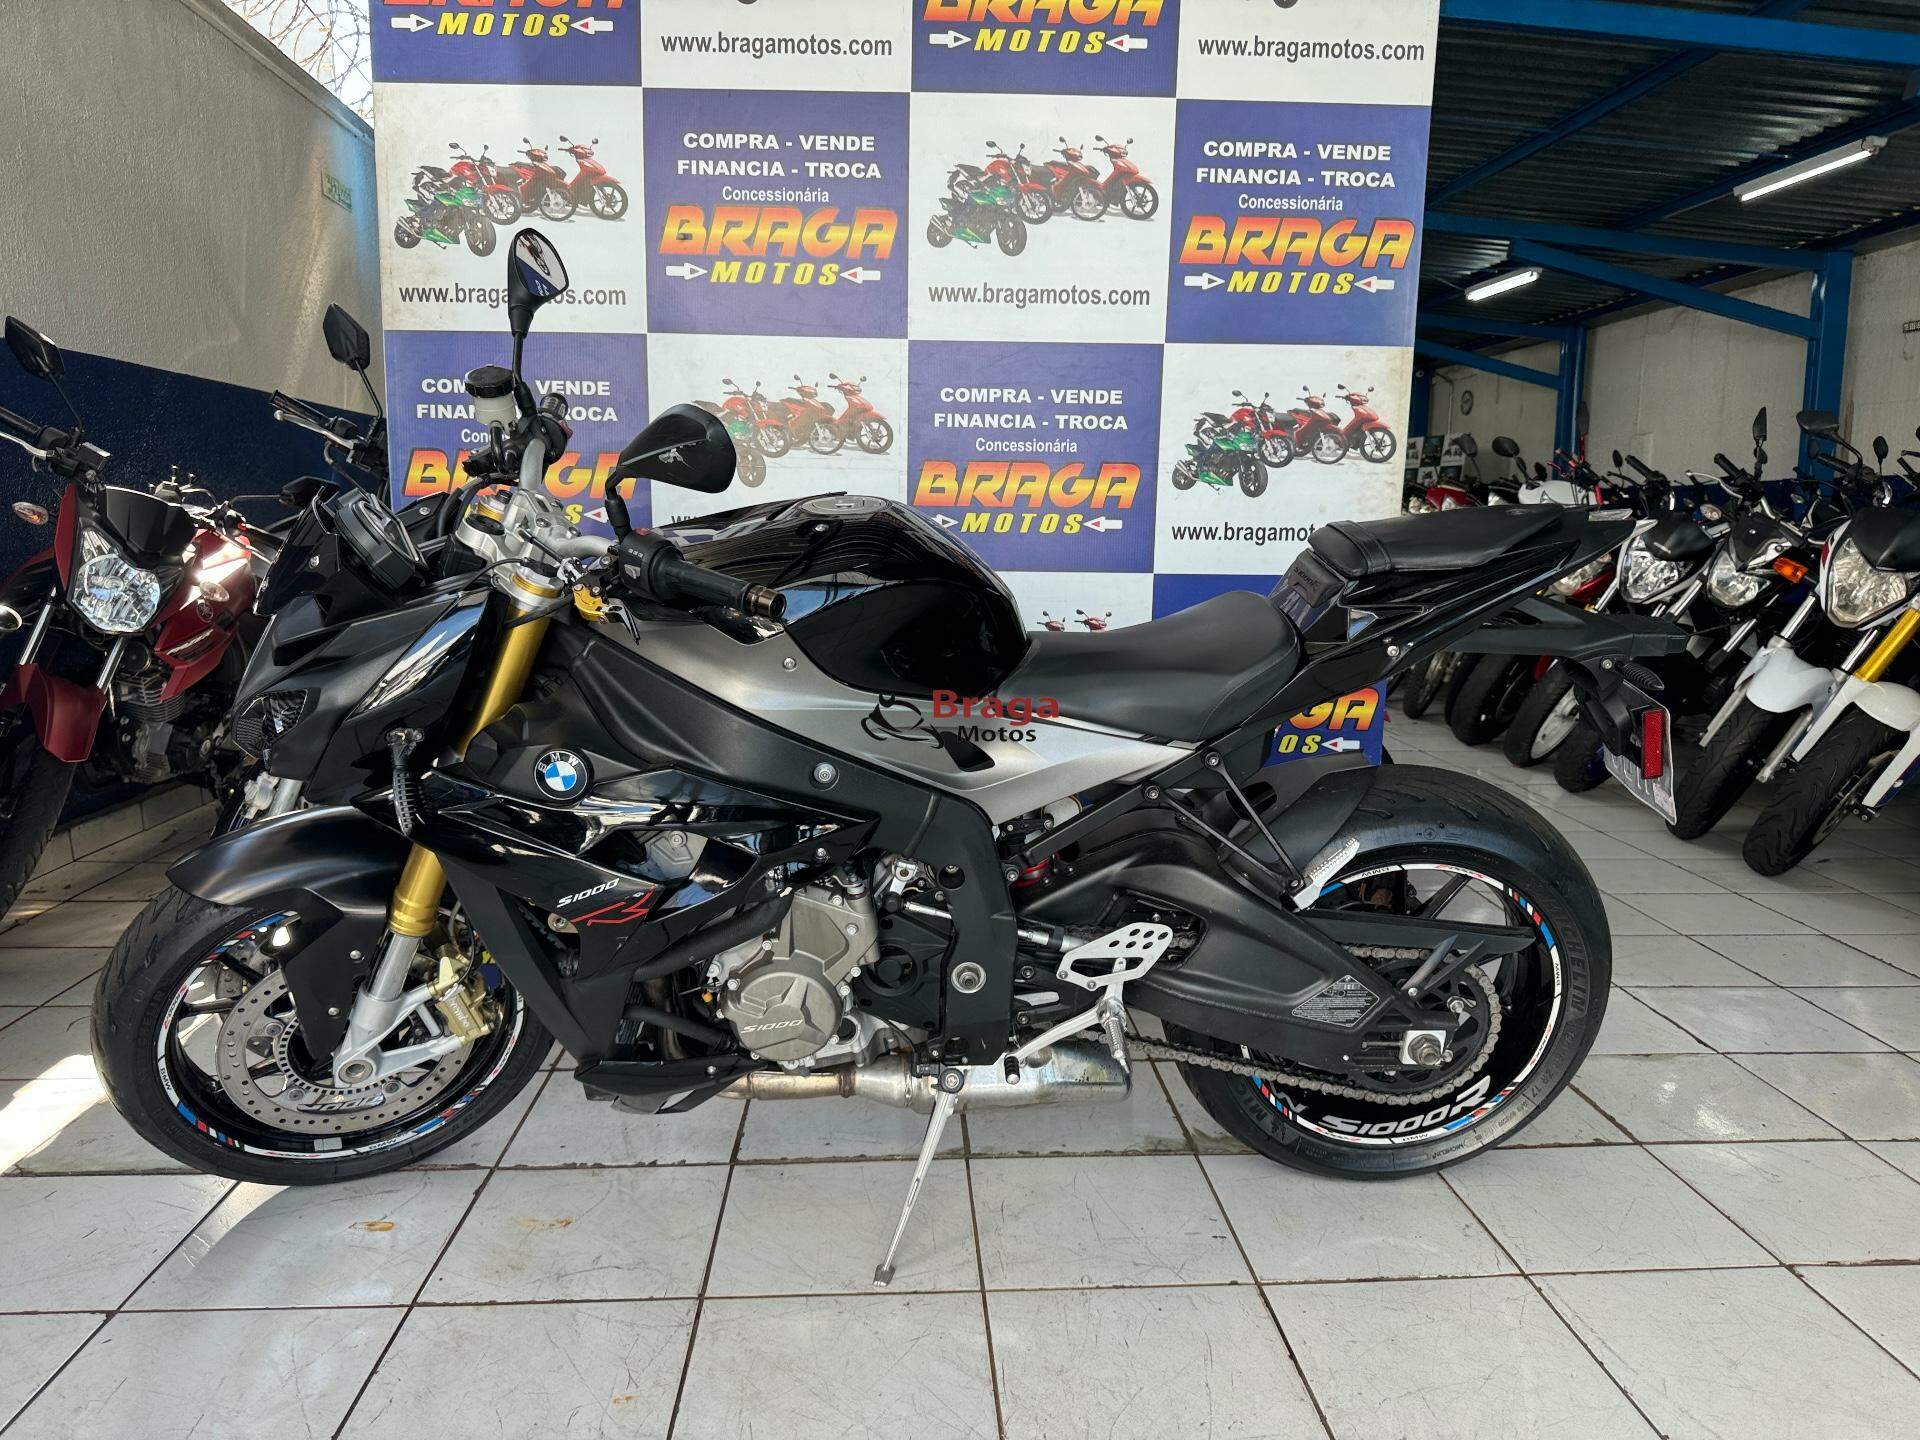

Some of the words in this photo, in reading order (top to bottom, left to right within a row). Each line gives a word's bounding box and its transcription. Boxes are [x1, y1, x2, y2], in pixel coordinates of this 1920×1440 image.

[436, 12, 571, 37] MOTOS
[661, 32, 892, 58] www.bragamotos.com
[973, 28, 1106, 53] MOTOS
[1198, 36, 1424, 62] www.bragamotos.com
[683, 133, 779, 151] COMPRA
[799, 134, 875, 152] VENDE
[1203, 141, 1297, 159] COMPRA
[1317, 143, 1391, 162] VENDE
[677, 160, 785, 178] FINANCIA
[804, 161, 882, 179] TROCA
[1196, 167, 1301, 186] FINANCIA
[1321, 170, 1395, 188] TROCA
[722, 186, 829, 203] Concessionária
[1238, 194, 1343, 211] Concessionária
[659, 205, 898, 259] BRAGA
[1179, 214, 1415, 269] BRAGA
[711, 260, 841, 285] MOTOS
[1227, 270, 1356, 295] MOTOS
[399, 283, 627, 309] www.bragaos.com
[928, 282, 1150, 308] www.bragamotos.com
[535, 380, 611, 396] VENDE
[940, 387, 1031, 403] COMPRA
[1050, 388, 1123, 405] VENDE
[934, 412, 1036, 430] FINANCIA
[1055, 414, 1128, 431] TROCA
[976, 437, 1078, 453] Concessionária
[913, 460, 1142, 509] BRAGA
[961, 512, 1085, 534] MOTOS
[538, 752, 579, 774] BMW
[556, 877, 620, 909] S1000
[740, 1018, 803, 1034] S1000
[1318, 1075, 1491, 1136] S1000R
